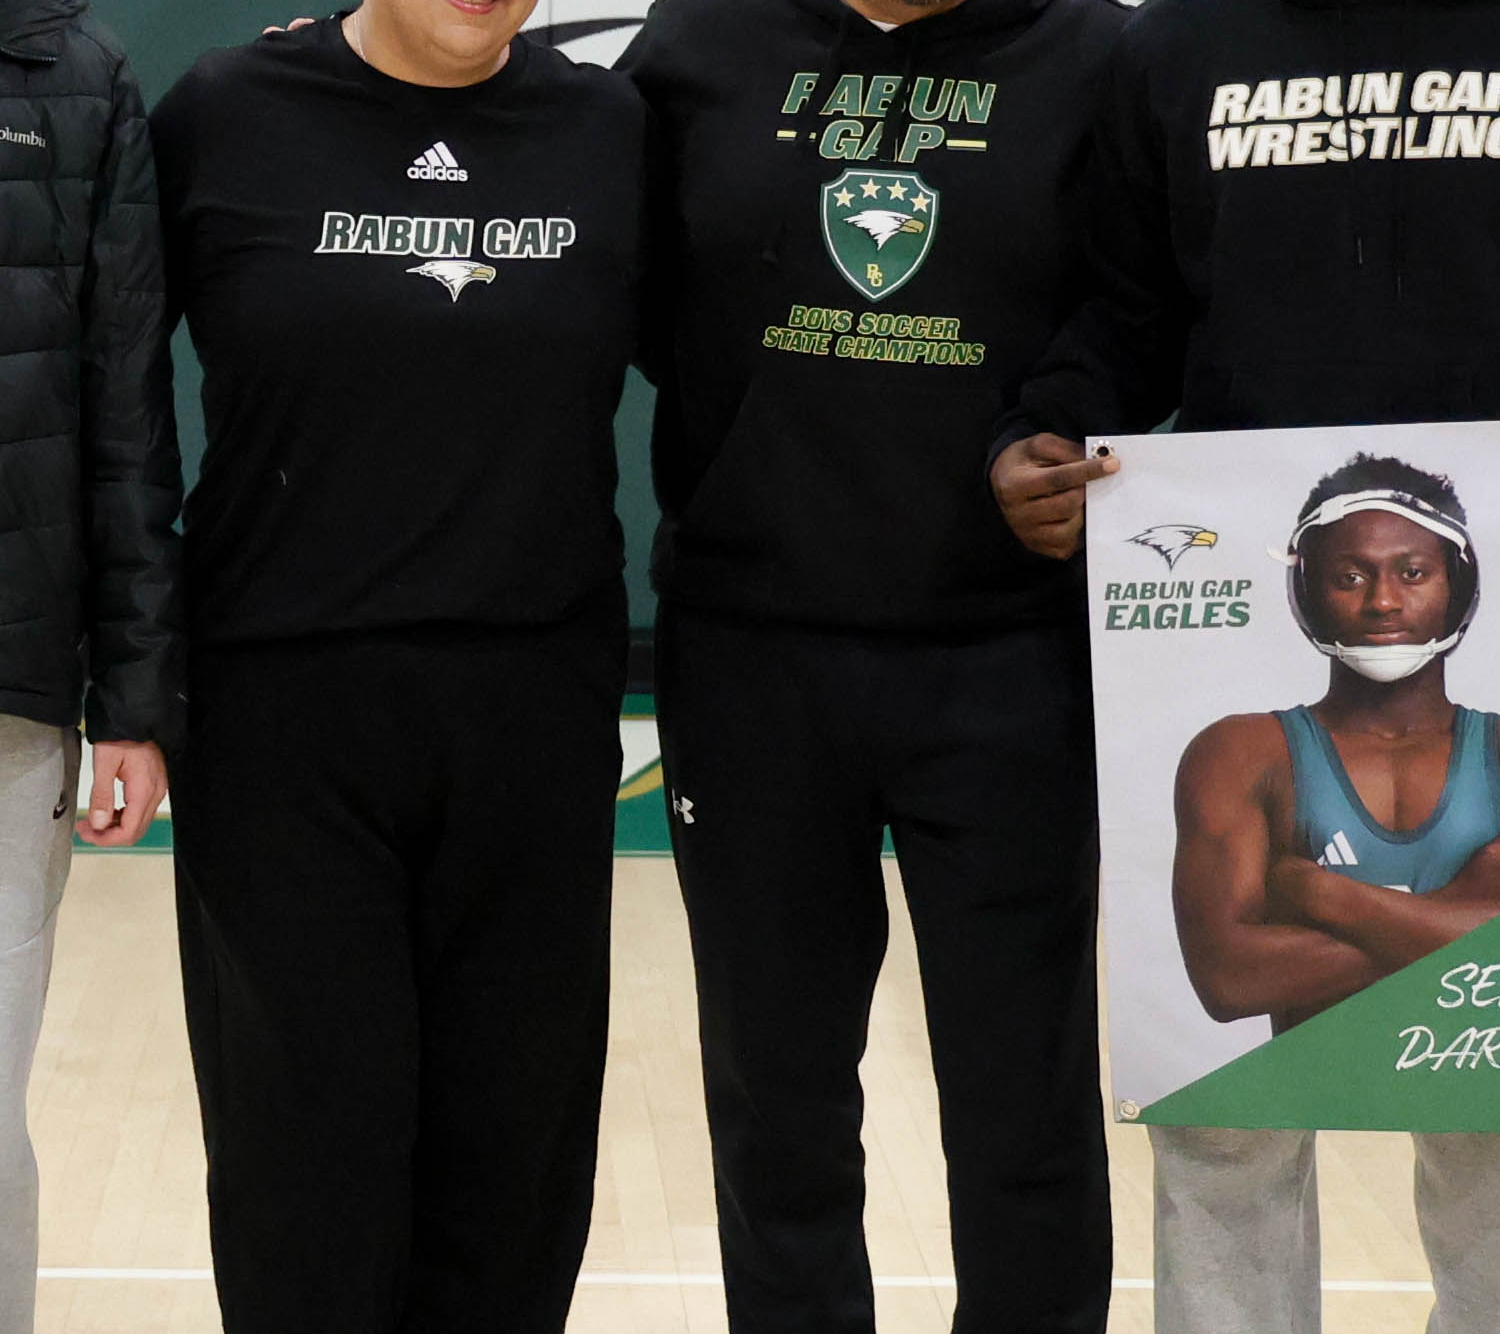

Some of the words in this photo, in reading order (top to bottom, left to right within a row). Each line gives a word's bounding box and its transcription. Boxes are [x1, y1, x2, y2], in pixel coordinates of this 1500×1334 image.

[1208, 72, 1404, 127] RABUN
[406, 164, 469, 183] adidas
[313, 211, 475, 258] RABUN
[482, 217, 577, 260] GAP
[788, 304, 854, 332] BOYS
[856, 312, 961, 341] SOCCER
[762, 326, 830, 355] STATE
[835, 336, 987, 366] CHAMPIONS
[1103, 580, 1198, 602] RABUN
[1200, 579, 1253, 598] GAP
[1103, 601, 1252, 632] EAGLES
